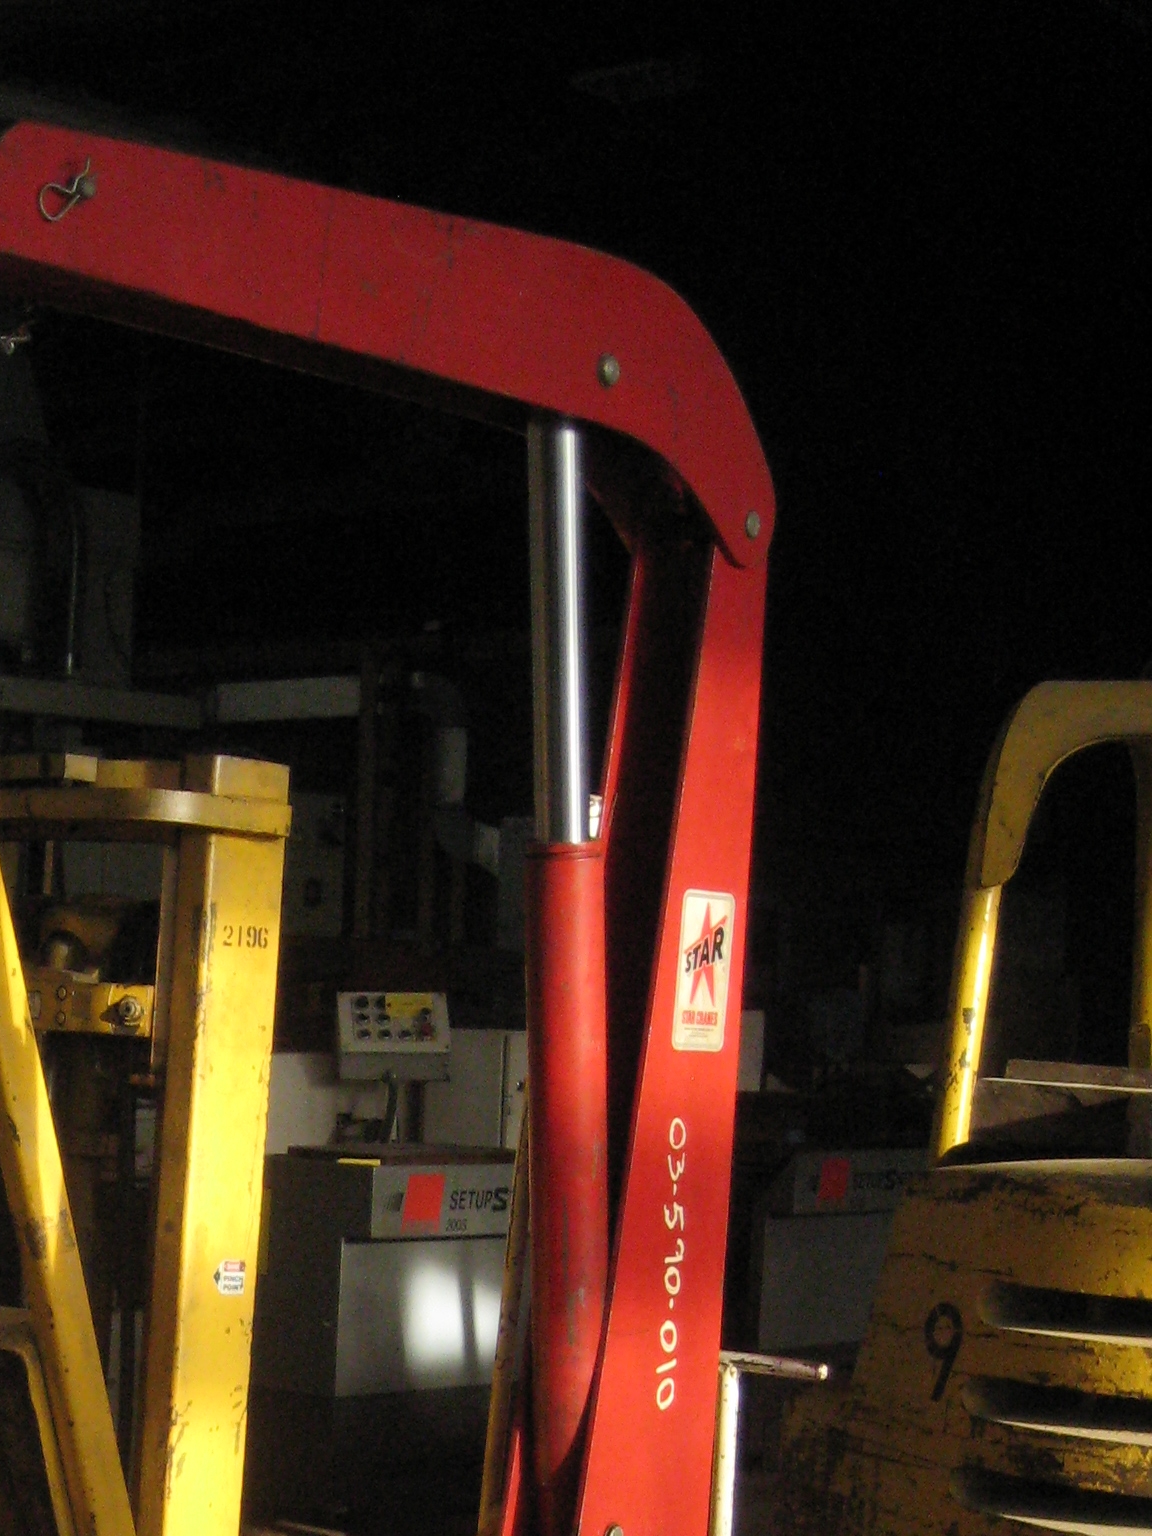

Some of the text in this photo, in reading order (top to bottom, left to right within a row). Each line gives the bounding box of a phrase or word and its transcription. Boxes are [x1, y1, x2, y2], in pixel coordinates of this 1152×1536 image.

[222, 925, 268, 949] 2196
[685, 926, 724, 973] STAR
[924, 1302, 963, 1402] 9
